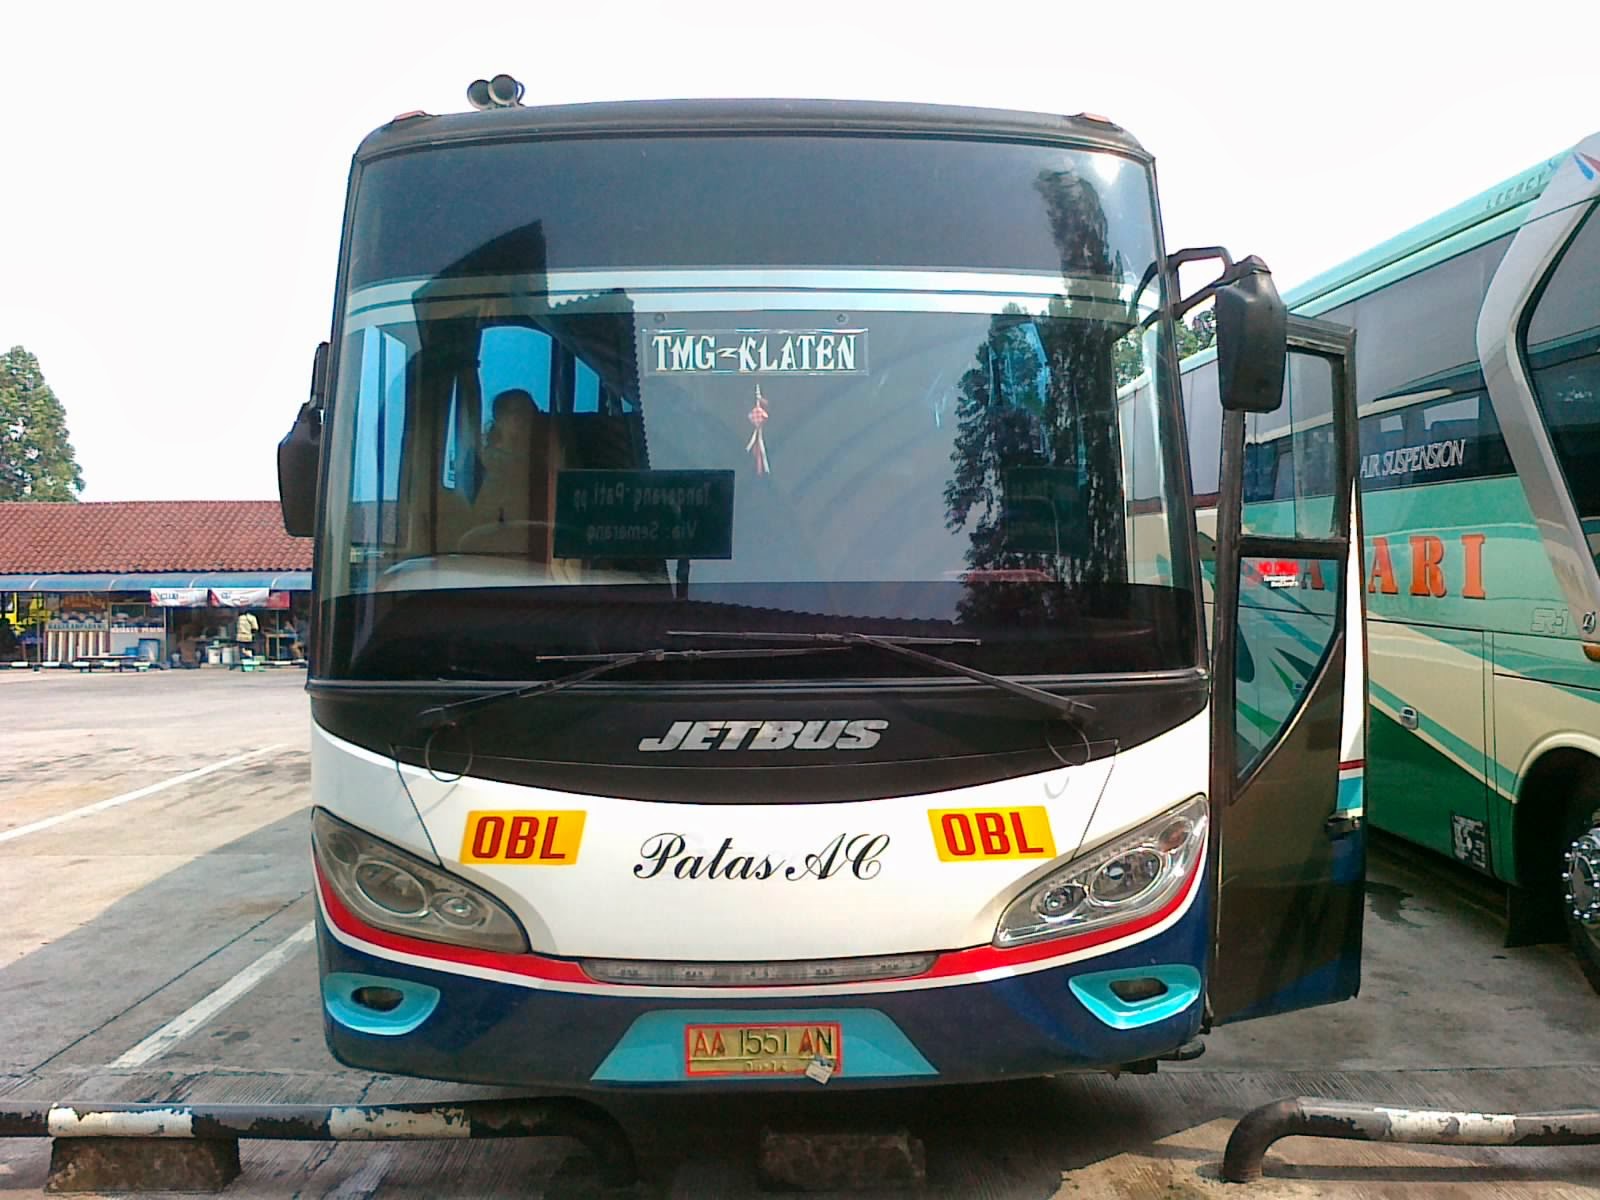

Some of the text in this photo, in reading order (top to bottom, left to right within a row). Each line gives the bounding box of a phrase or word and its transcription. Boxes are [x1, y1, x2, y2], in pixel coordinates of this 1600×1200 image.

[1360, 439, 1466, 478] AIR SUSPENSION
[638, 719, 889, 752] JETBUS
[471, 816, 566, 861] OBL
[940, 811, 1045, 857] OBL
[633, 832, 891, 881] Patas AC
[693, 1027, 833, 1058] AA 1551 AN
